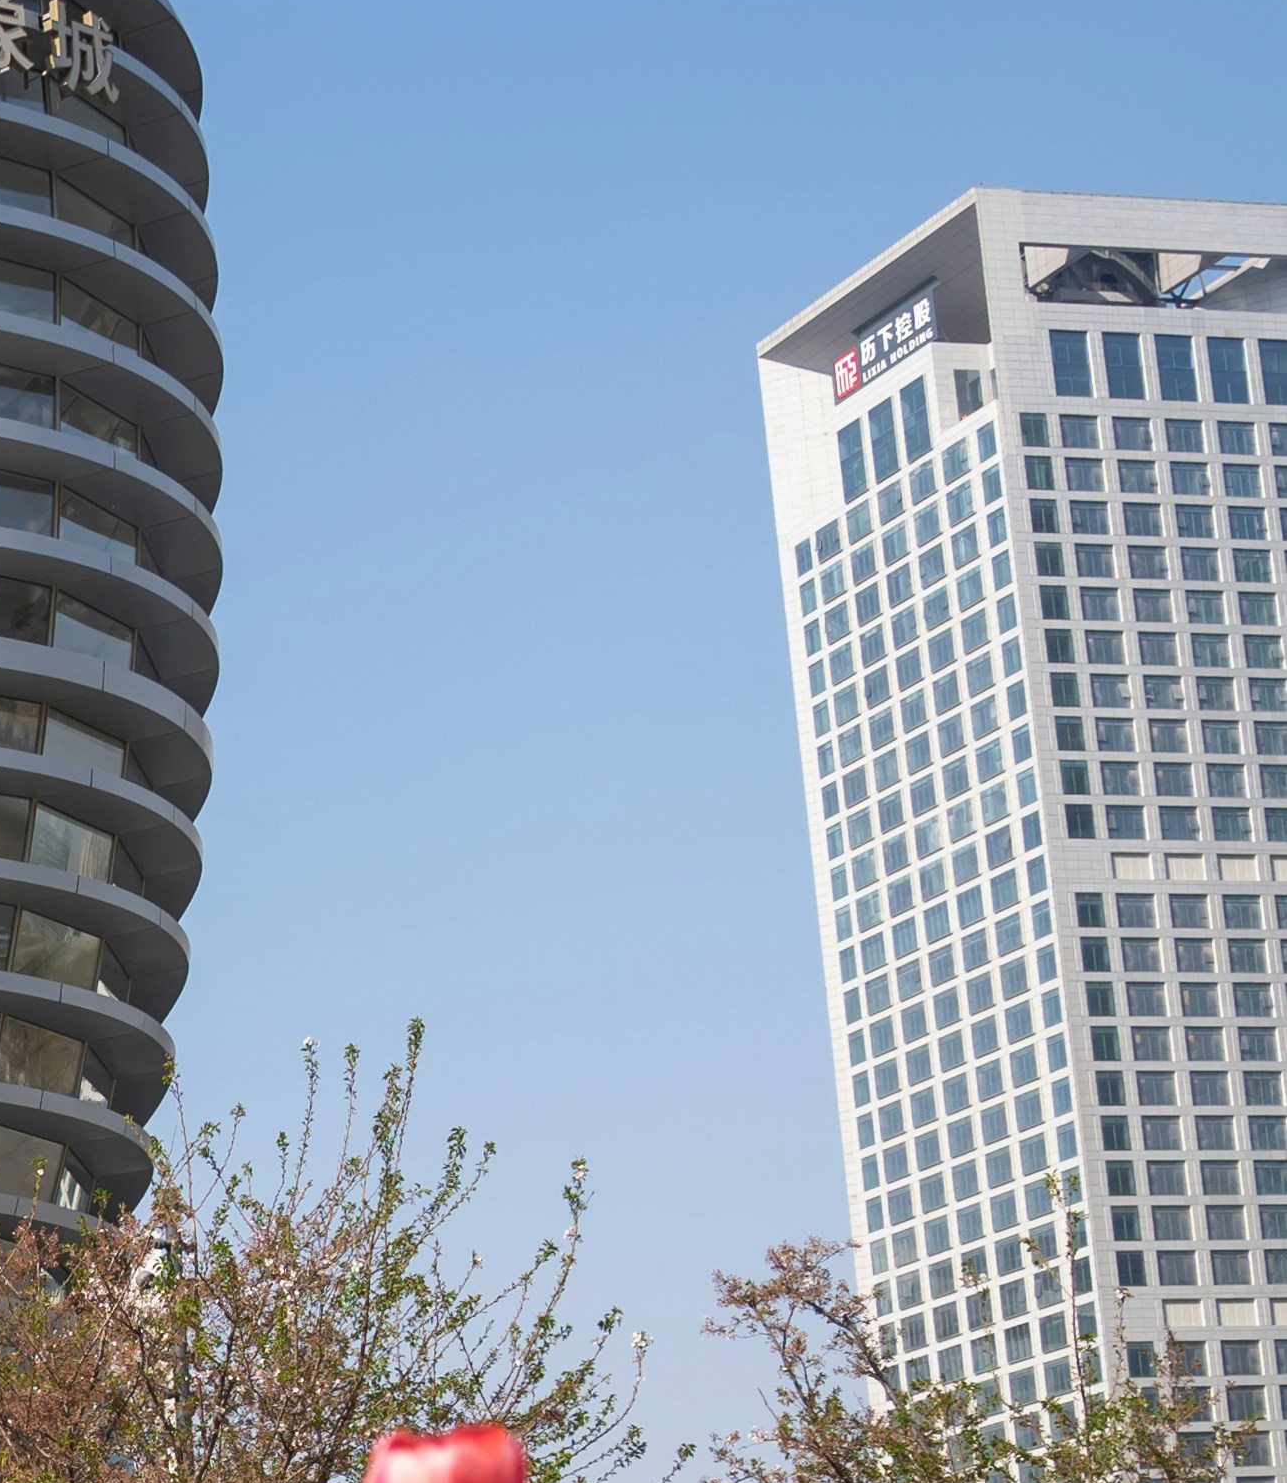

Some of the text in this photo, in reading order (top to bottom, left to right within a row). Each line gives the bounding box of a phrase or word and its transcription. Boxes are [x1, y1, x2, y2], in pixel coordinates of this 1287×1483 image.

[860, 297, 932, 367] 历下控股
[862, 358, 888, 384] LIXIA
[889, 326, 934, 365] HOLDING
